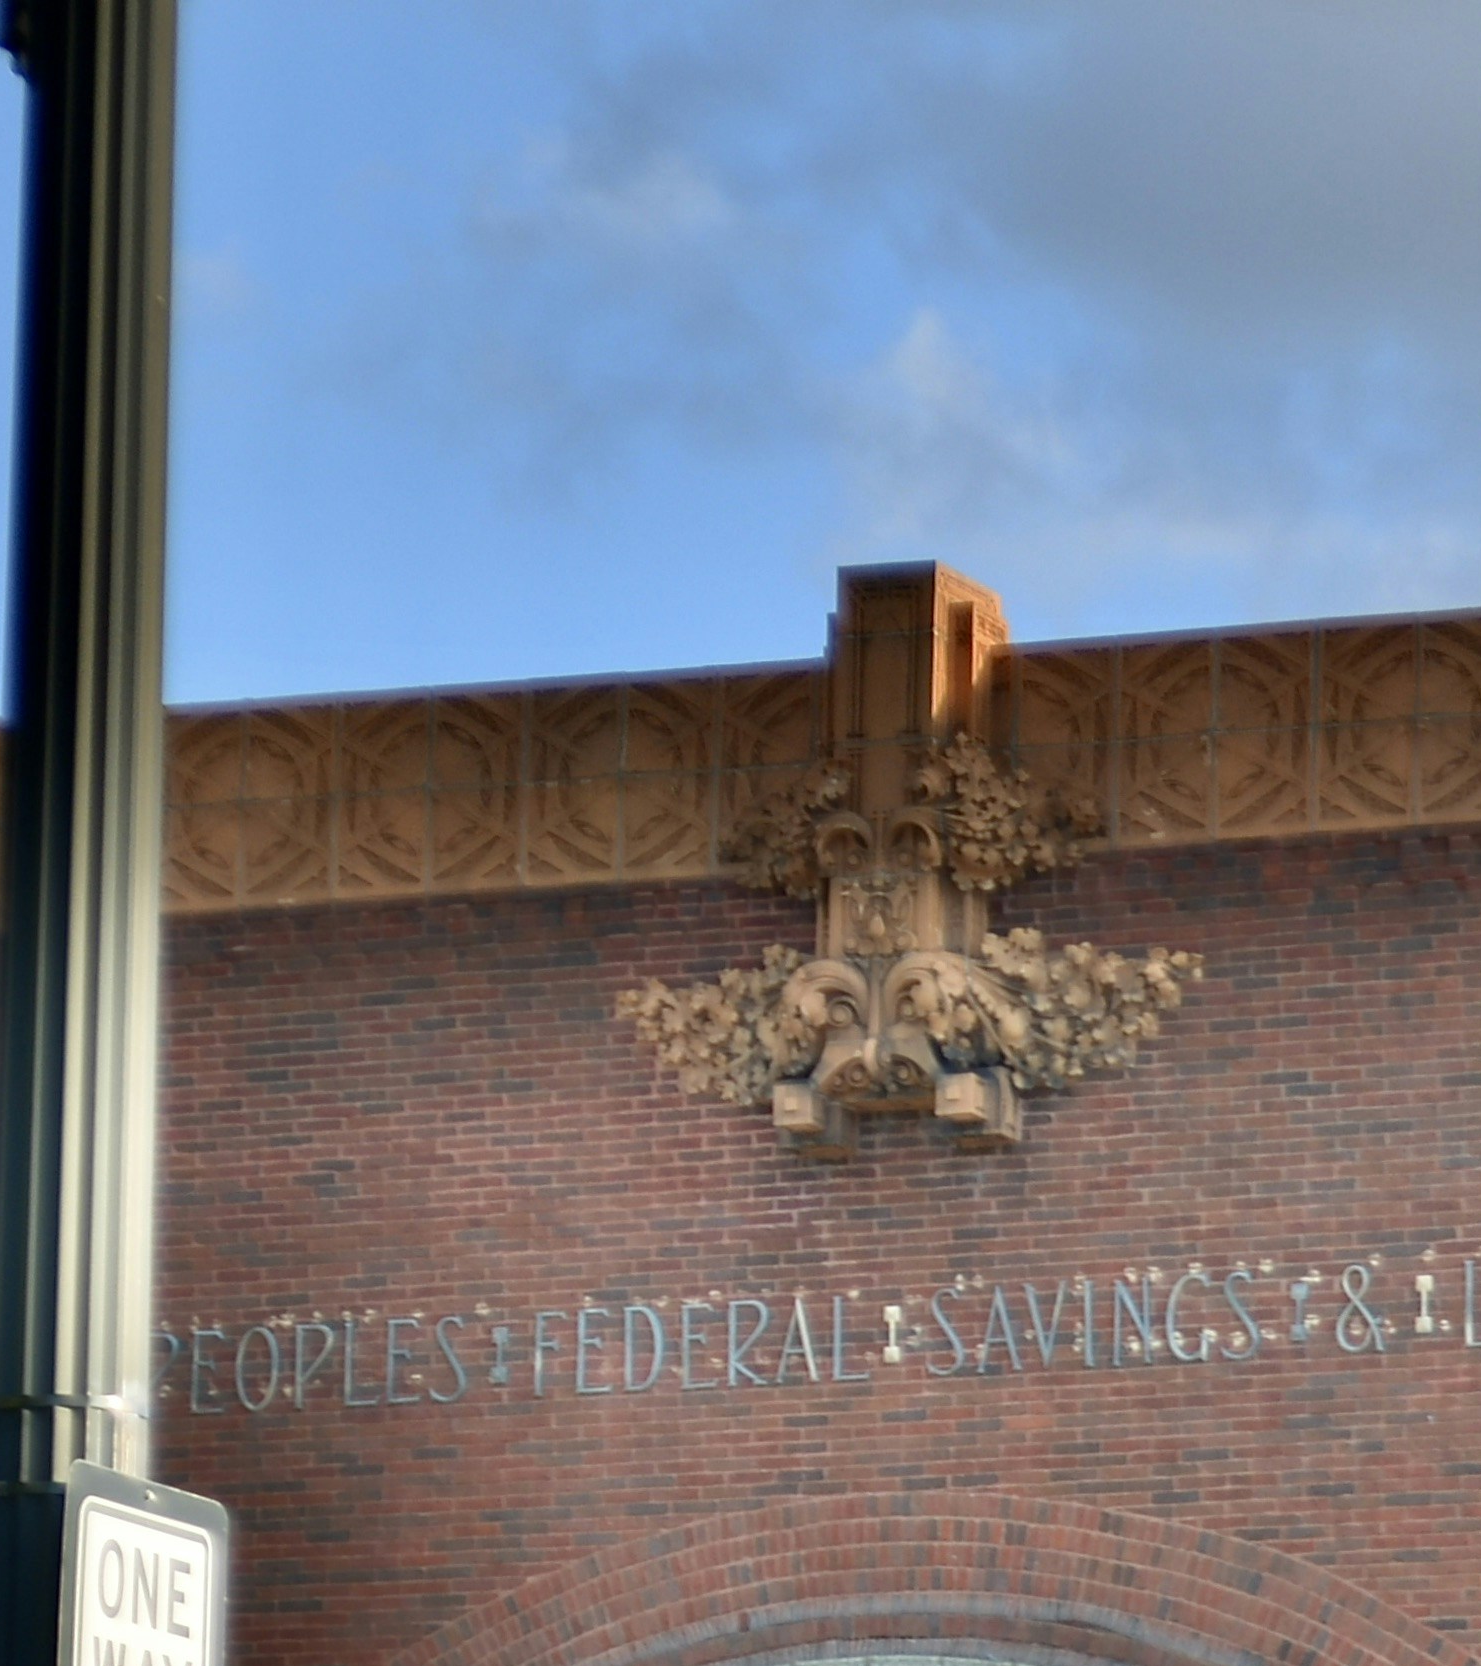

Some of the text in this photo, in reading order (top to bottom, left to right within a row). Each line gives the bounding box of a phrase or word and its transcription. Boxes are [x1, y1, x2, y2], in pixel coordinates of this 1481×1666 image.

[532, 1294, 869, 1397] FEDERAL
[925, 1269, 1261, 1376] SAVINGS
[1335, 1262, 1384, 1353] &
[97, 1538, 192, 1640] ONE
